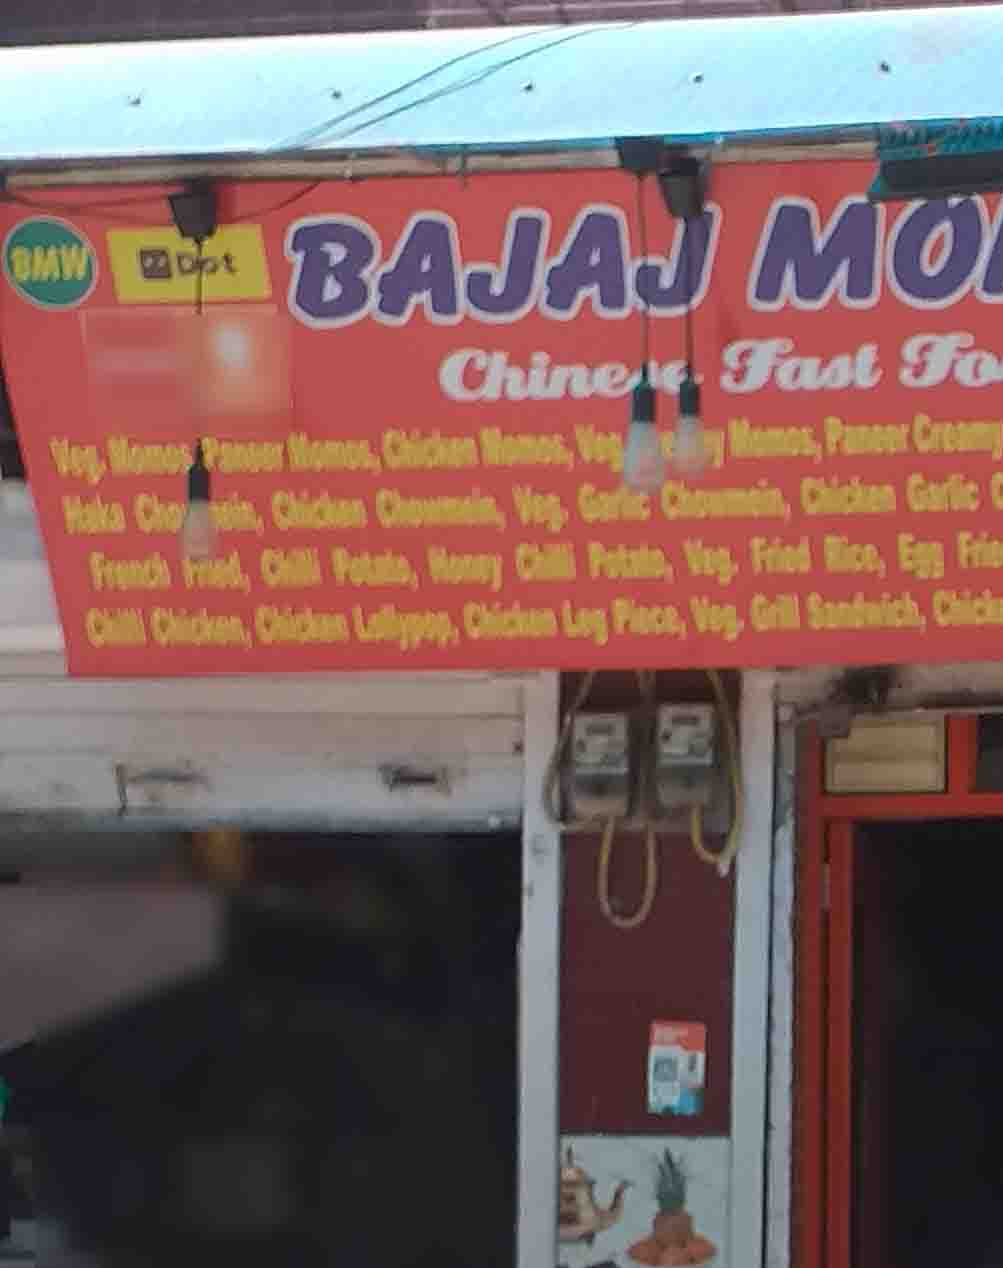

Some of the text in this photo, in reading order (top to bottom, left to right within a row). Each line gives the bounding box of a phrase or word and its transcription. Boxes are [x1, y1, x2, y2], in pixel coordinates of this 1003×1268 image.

[8, 242, 91, 284] BMW
[284, 203, 722, 331] BAJAJ
[720, 336, 883, 396] Fast
[898, 531, 945, 580] Egg
